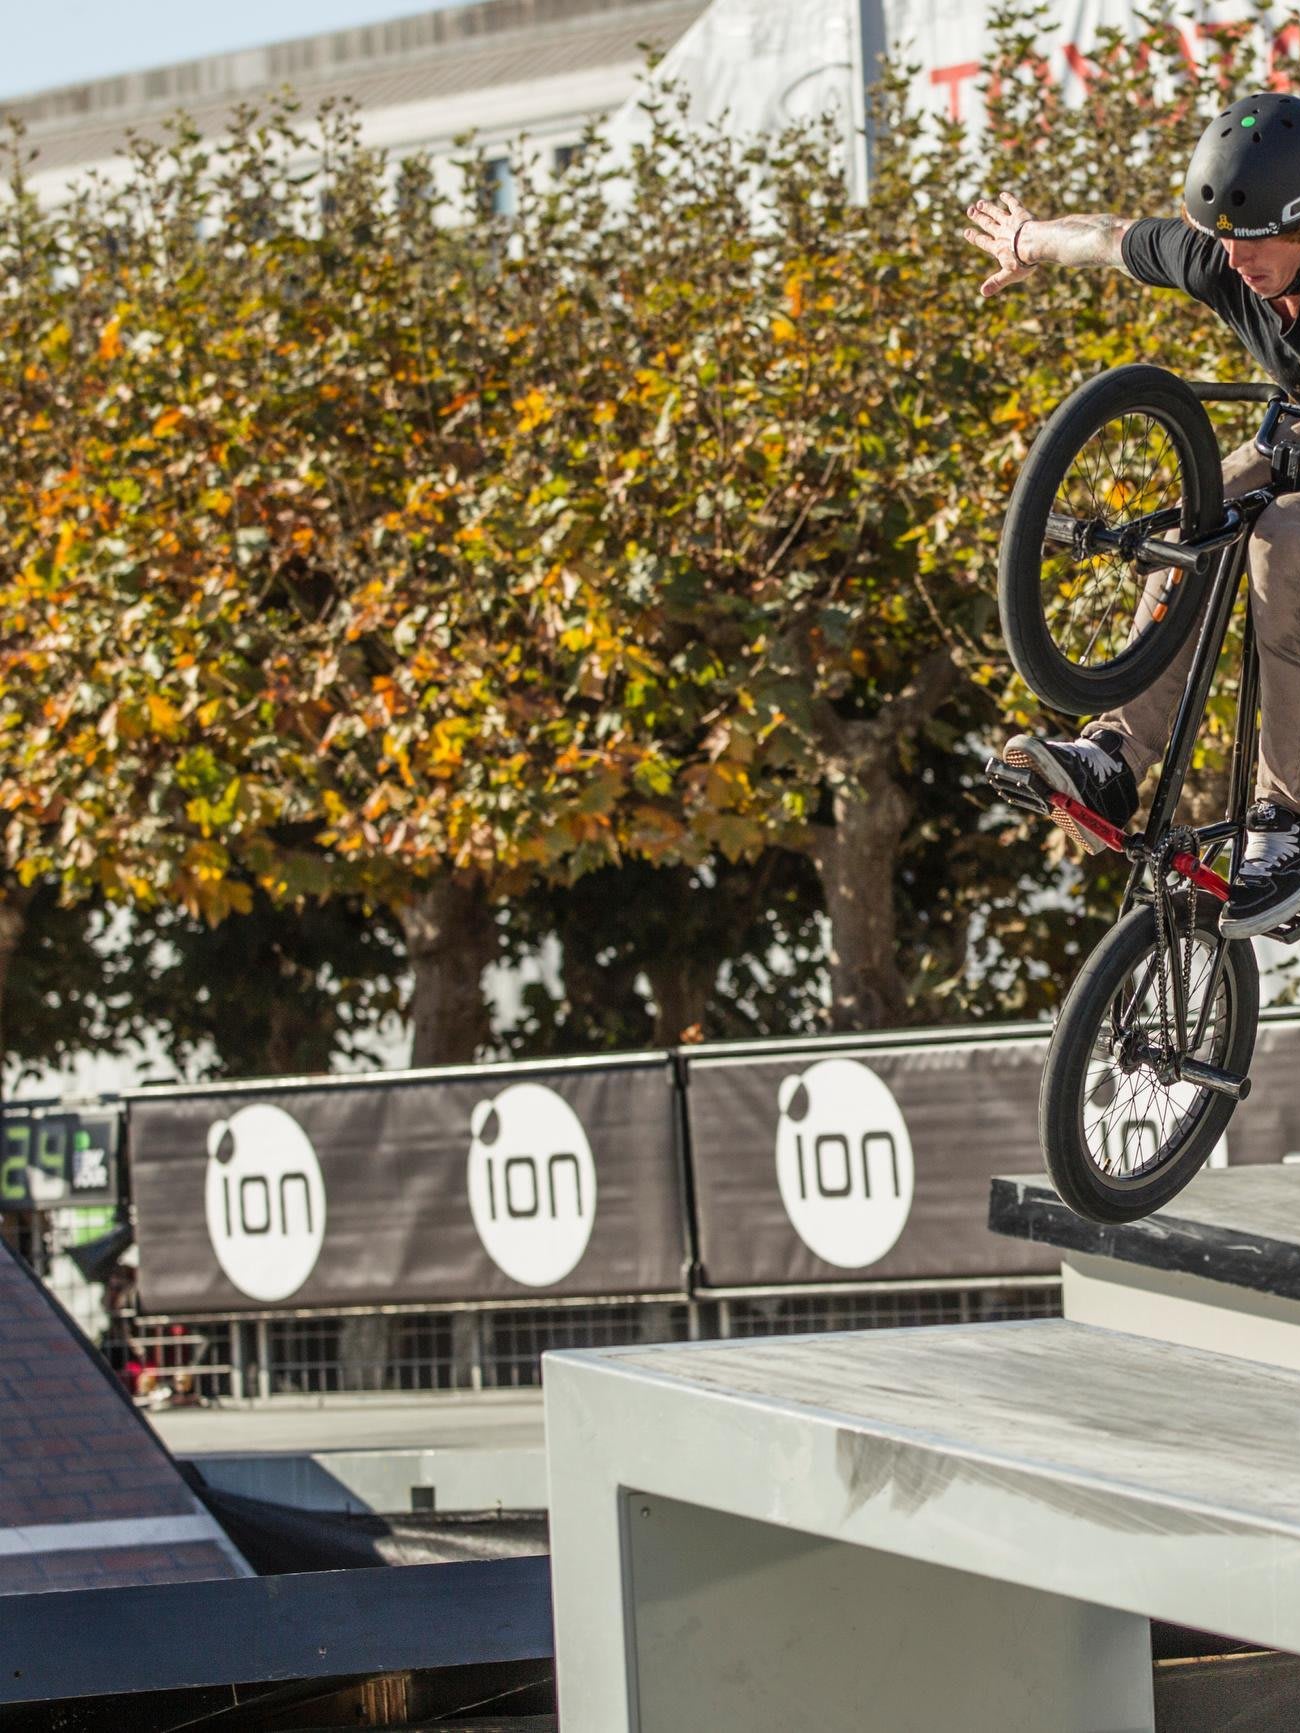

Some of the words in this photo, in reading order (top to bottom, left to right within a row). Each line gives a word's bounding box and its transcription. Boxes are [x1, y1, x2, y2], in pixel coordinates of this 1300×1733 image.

[214, 1128, 314, 1238] ion
[478, 1107, 584, 1221] ion
[786, 1082, 901, 1200] ion
